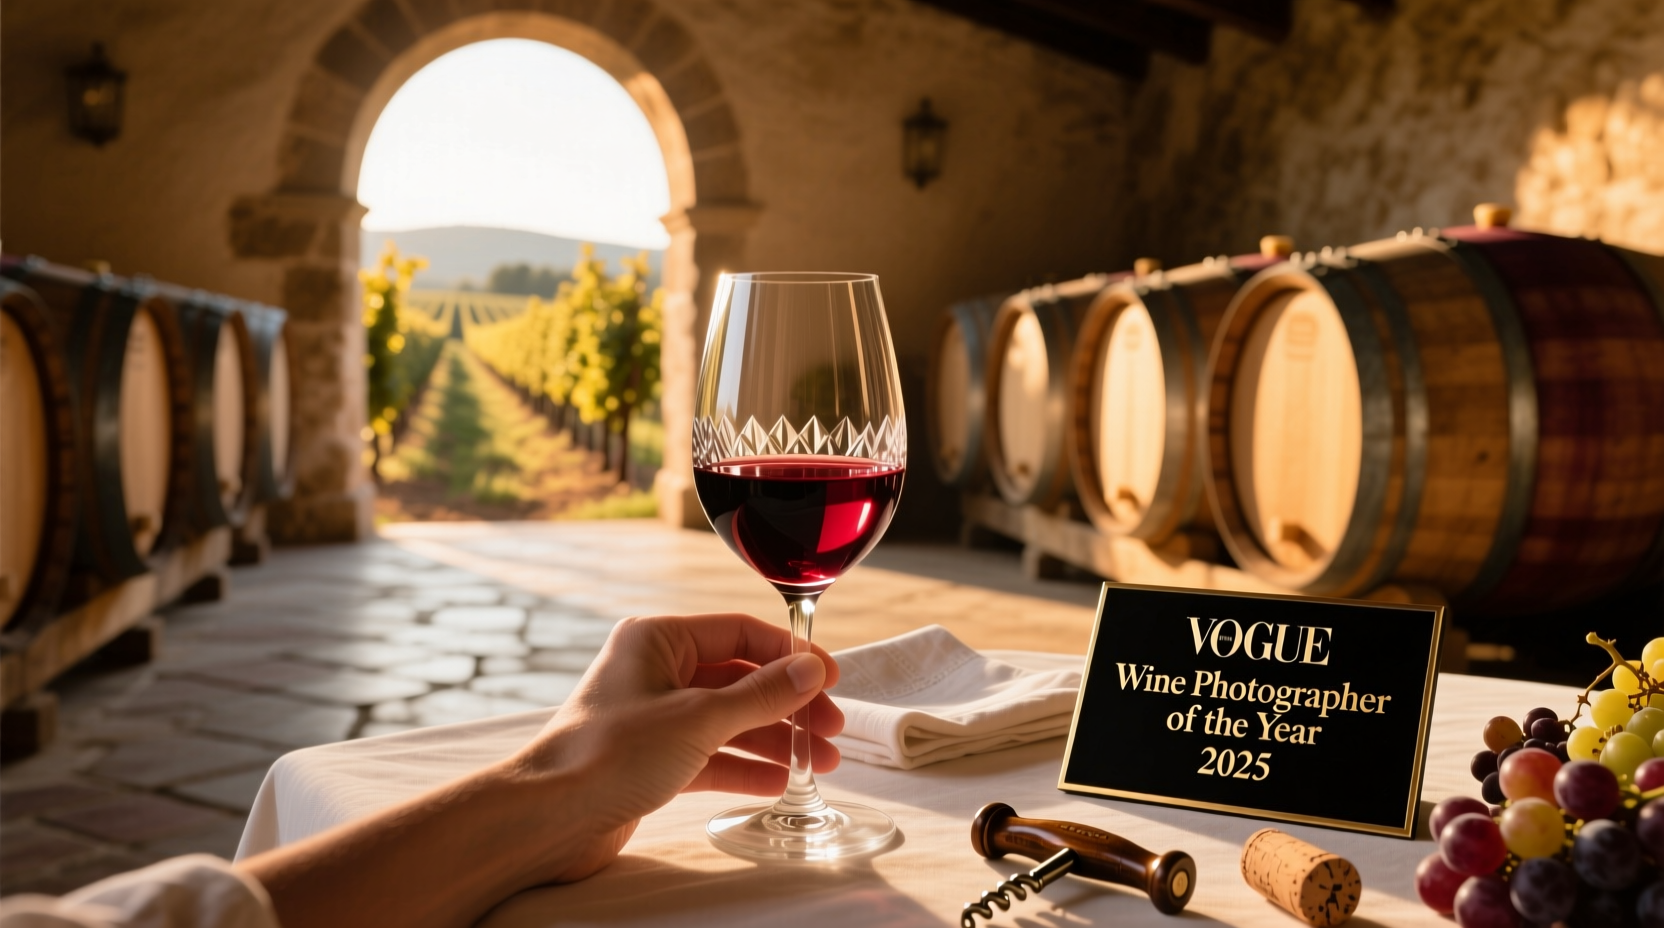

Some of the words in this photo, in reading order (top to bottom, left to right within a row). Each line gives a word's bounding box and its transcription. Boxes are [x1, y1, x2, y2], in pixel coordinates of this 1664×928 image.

[1187, 617, 1333, 666] VOGUE
[1116, 663, 1187, 695] Wine
[1191, 671, 1392, 718] Photographer
[1166, 704, 1202, 733] of
[1204, 707, 1249, 738] the
[1257, 712, 1323, 745] Year
[1197, 747, 1272, 781] 2025
